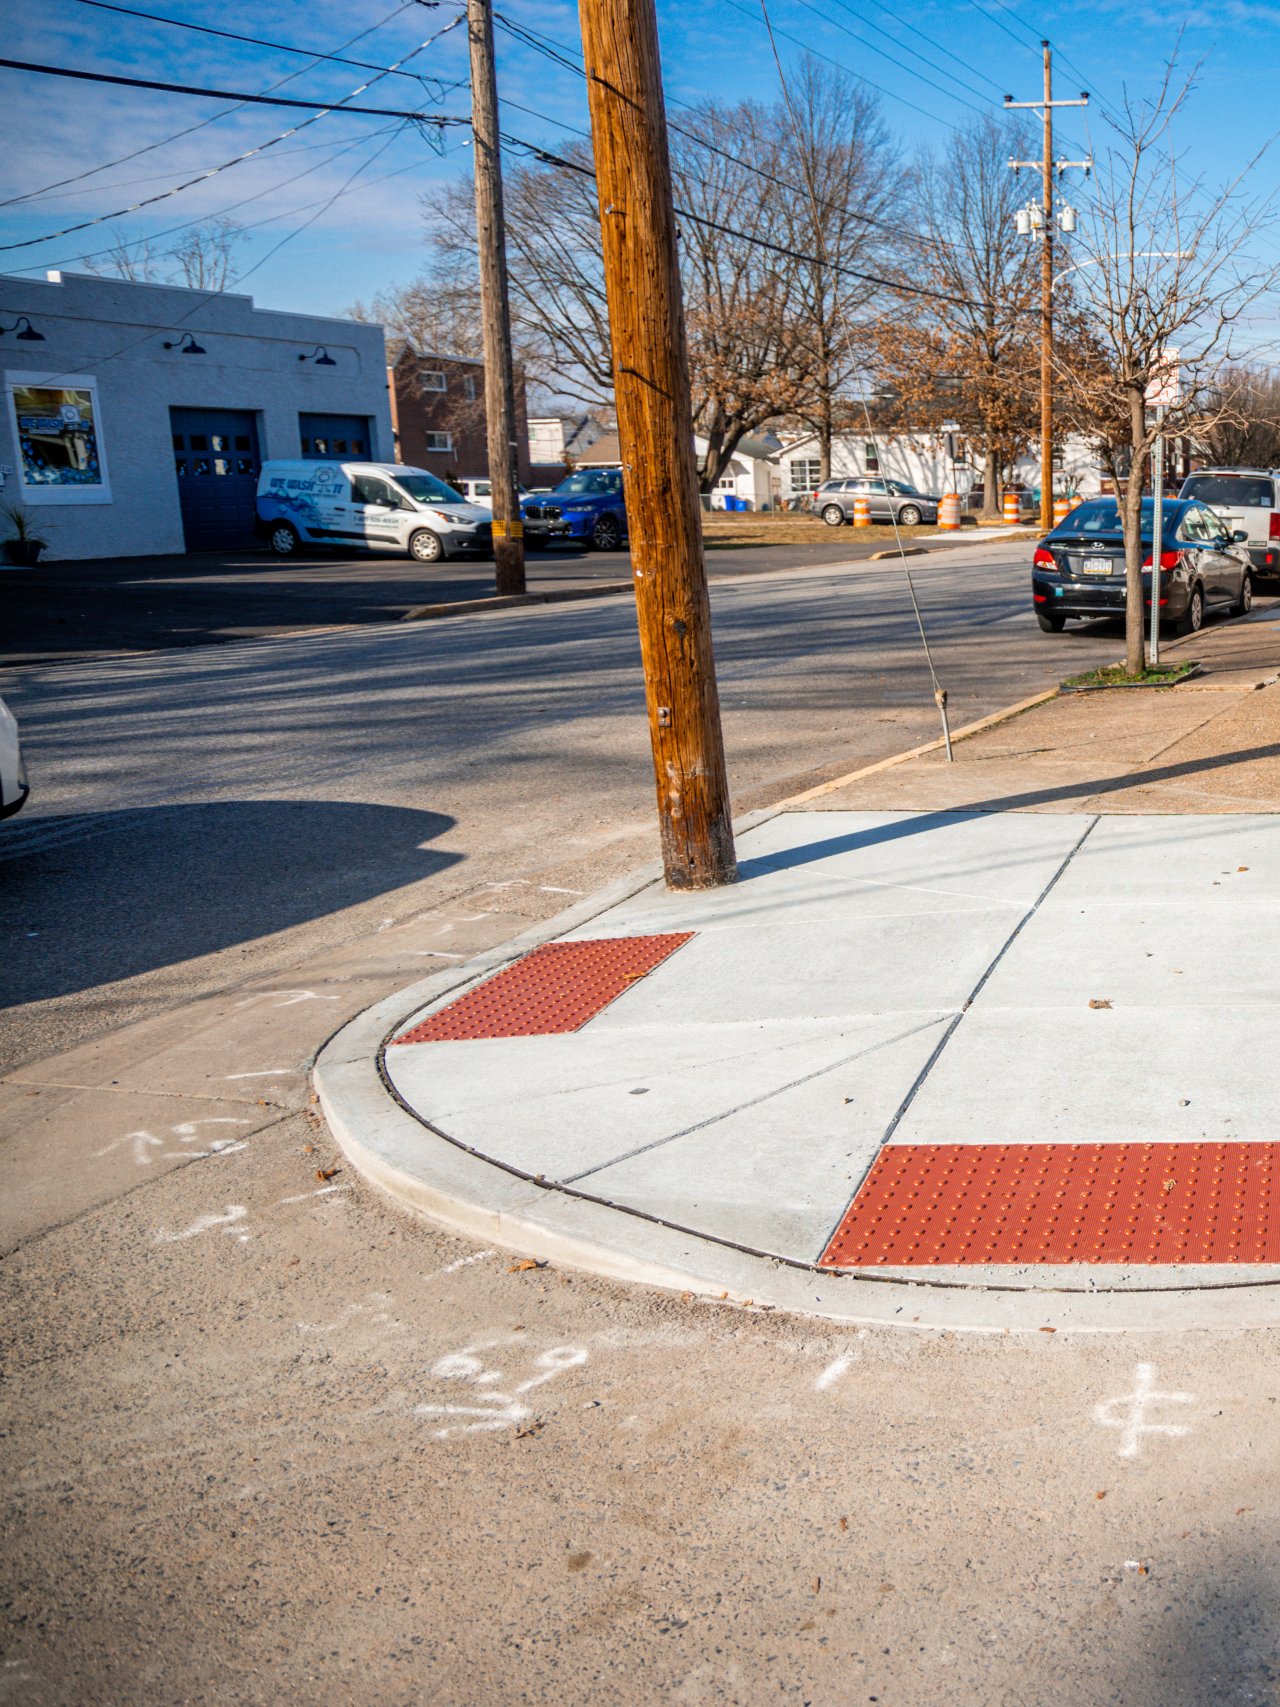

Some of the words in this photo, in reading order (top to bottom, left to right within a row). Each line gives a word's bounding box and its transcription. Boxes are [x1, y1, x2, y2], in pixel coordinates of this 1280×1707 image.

[270, 477, 286, 489] WE
[286, 479, 316, 492] WASH
[332, 483, 345, 495] IT
